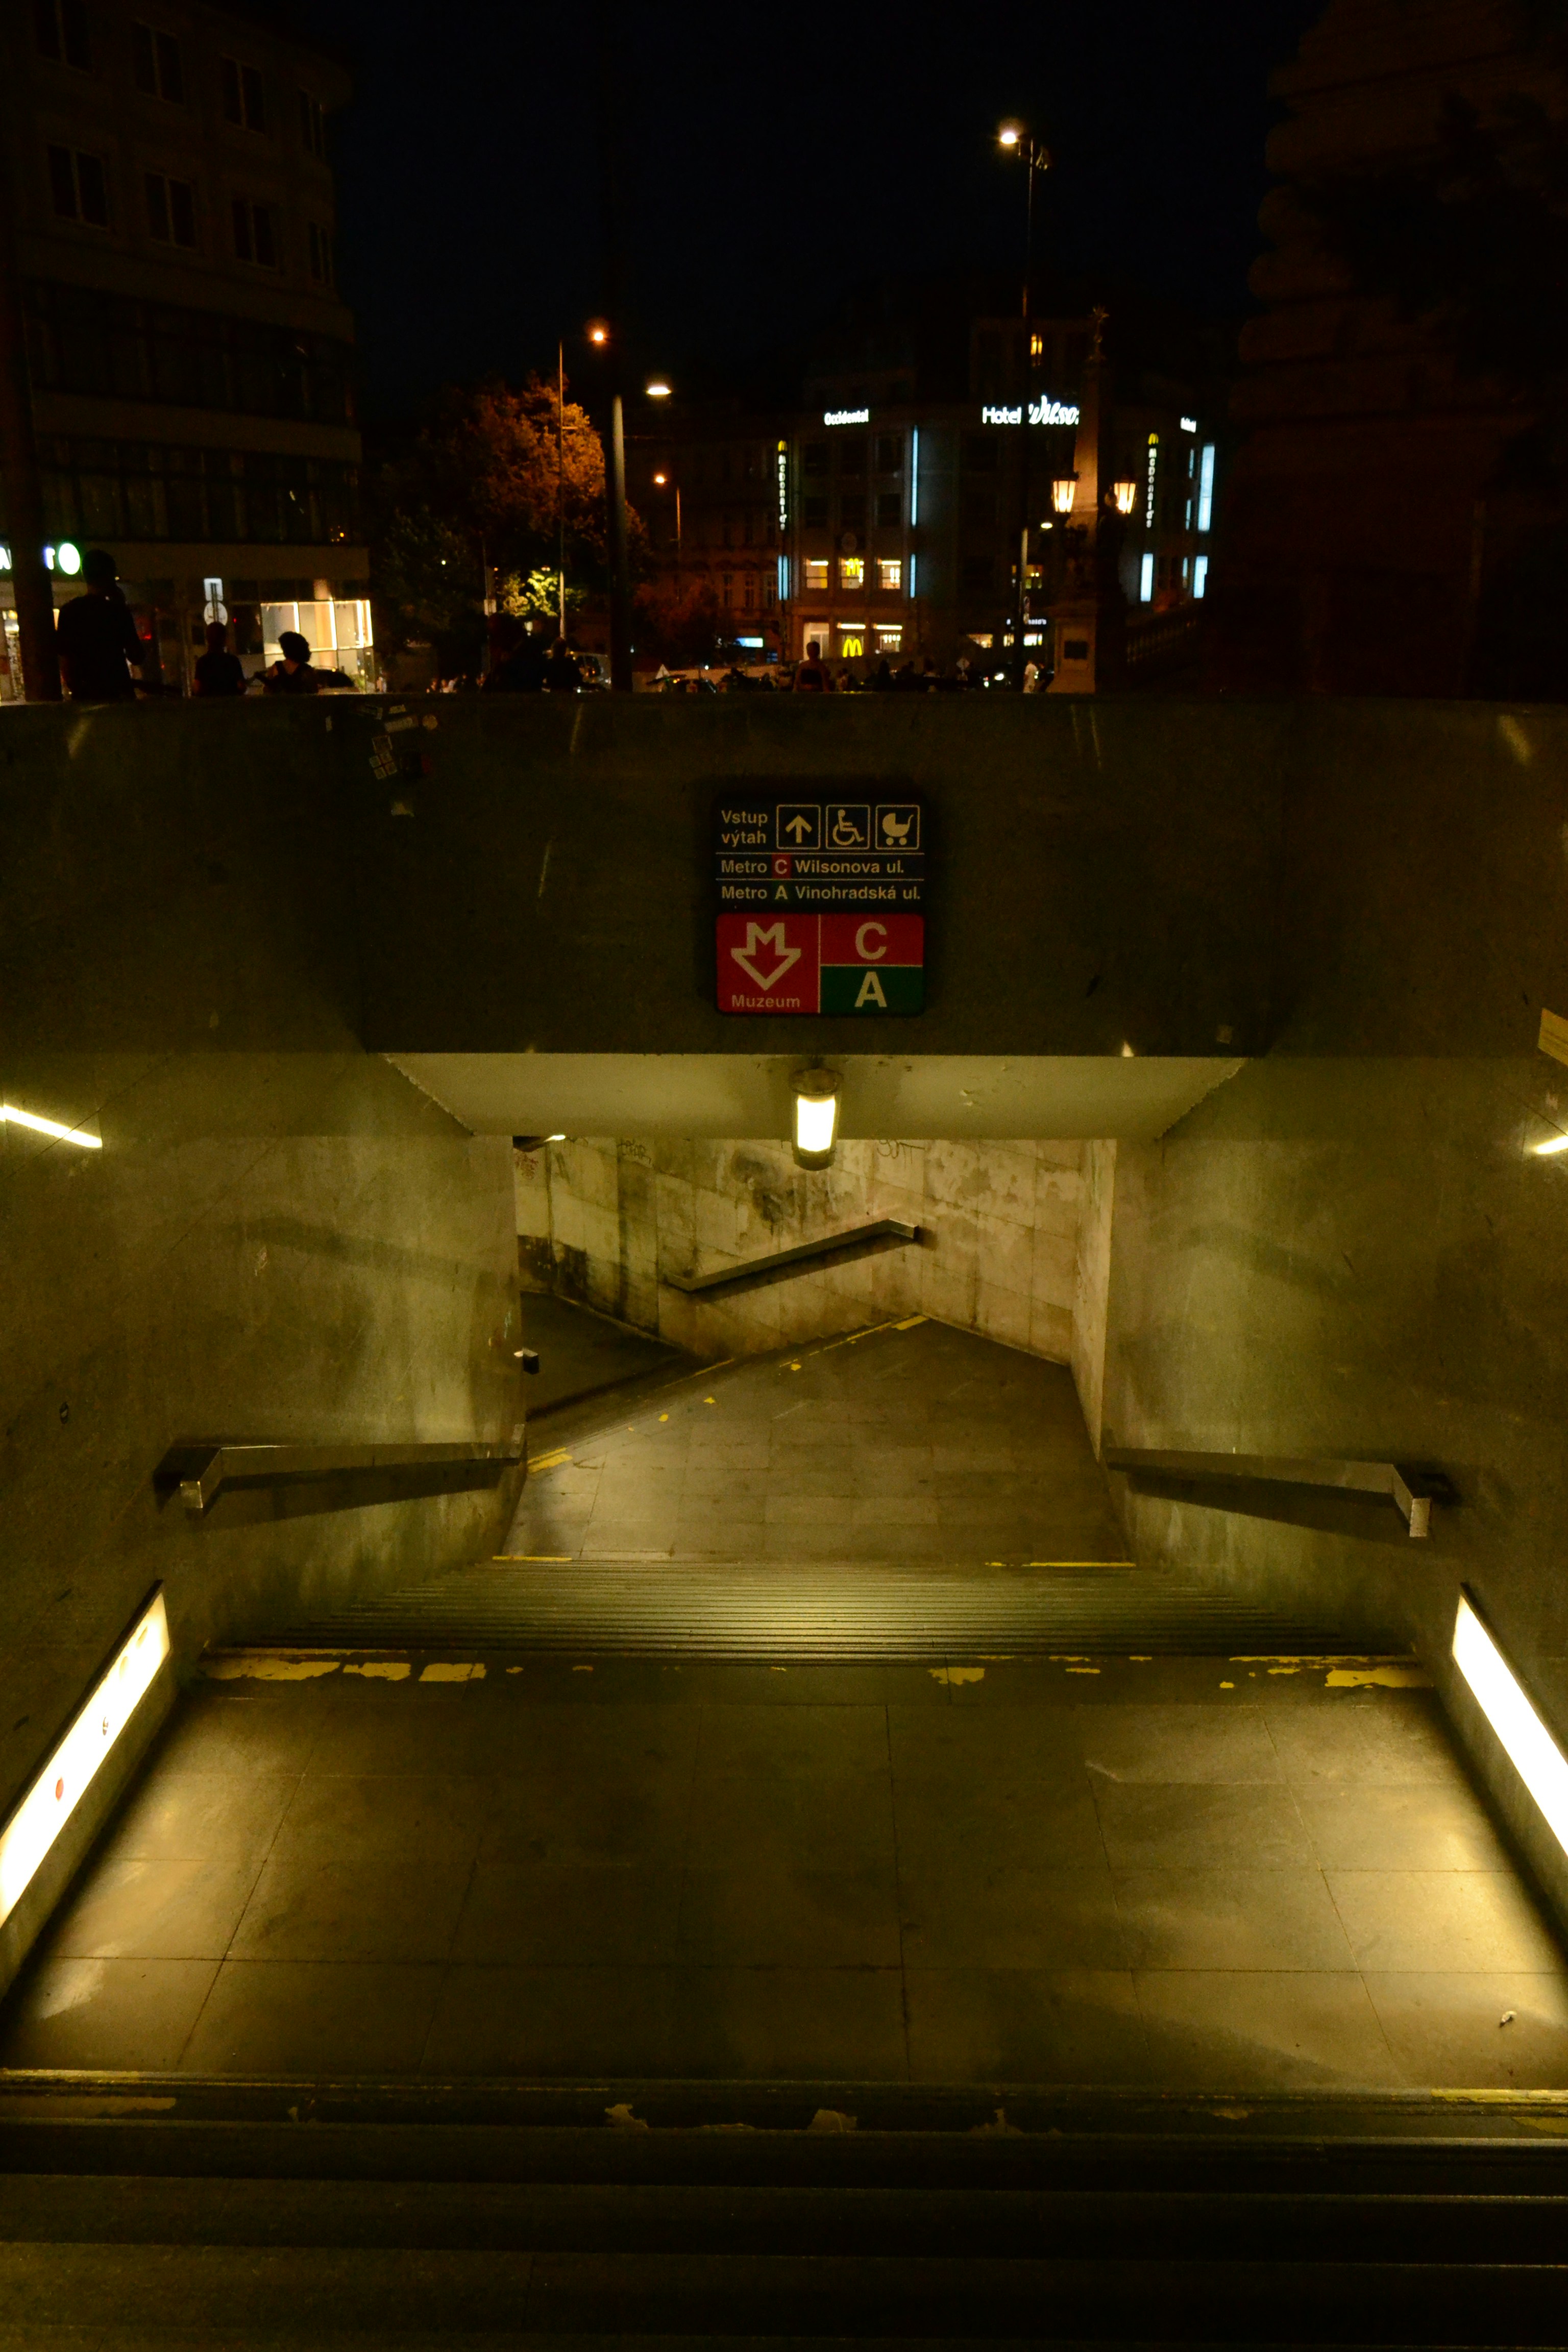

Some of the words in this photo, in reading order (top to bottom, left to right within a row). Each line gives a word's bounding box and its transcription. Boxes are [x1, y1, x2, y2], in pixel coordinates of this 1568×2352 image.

[824, 408, 869, 426] Occidental
[983, 406, 1022, 424] Hotel
[778, 454, 787, 531] McDonald's
[1146, 448, 1157, 528] McDonald's
[721, 810, 768, 827] Vstup
[721, 829, 767, 847] výtah
[721, 860, 768, 874] Metro
[774, 859, 788, 874] C
[794, 860, 880, 874] Wilsonova
[886, 860, 904, 874] ul.
[721, 886, 768, 900] Metro
[774, 885, 789, 900] A
[795, 885, 896, 900] Vinohradská
[902, 886, 921, 900] ul.
[855, 922, 887, 960] C
[854, 971, 887, 1008] A
[731, 994, 801, 1008] Muzeum
